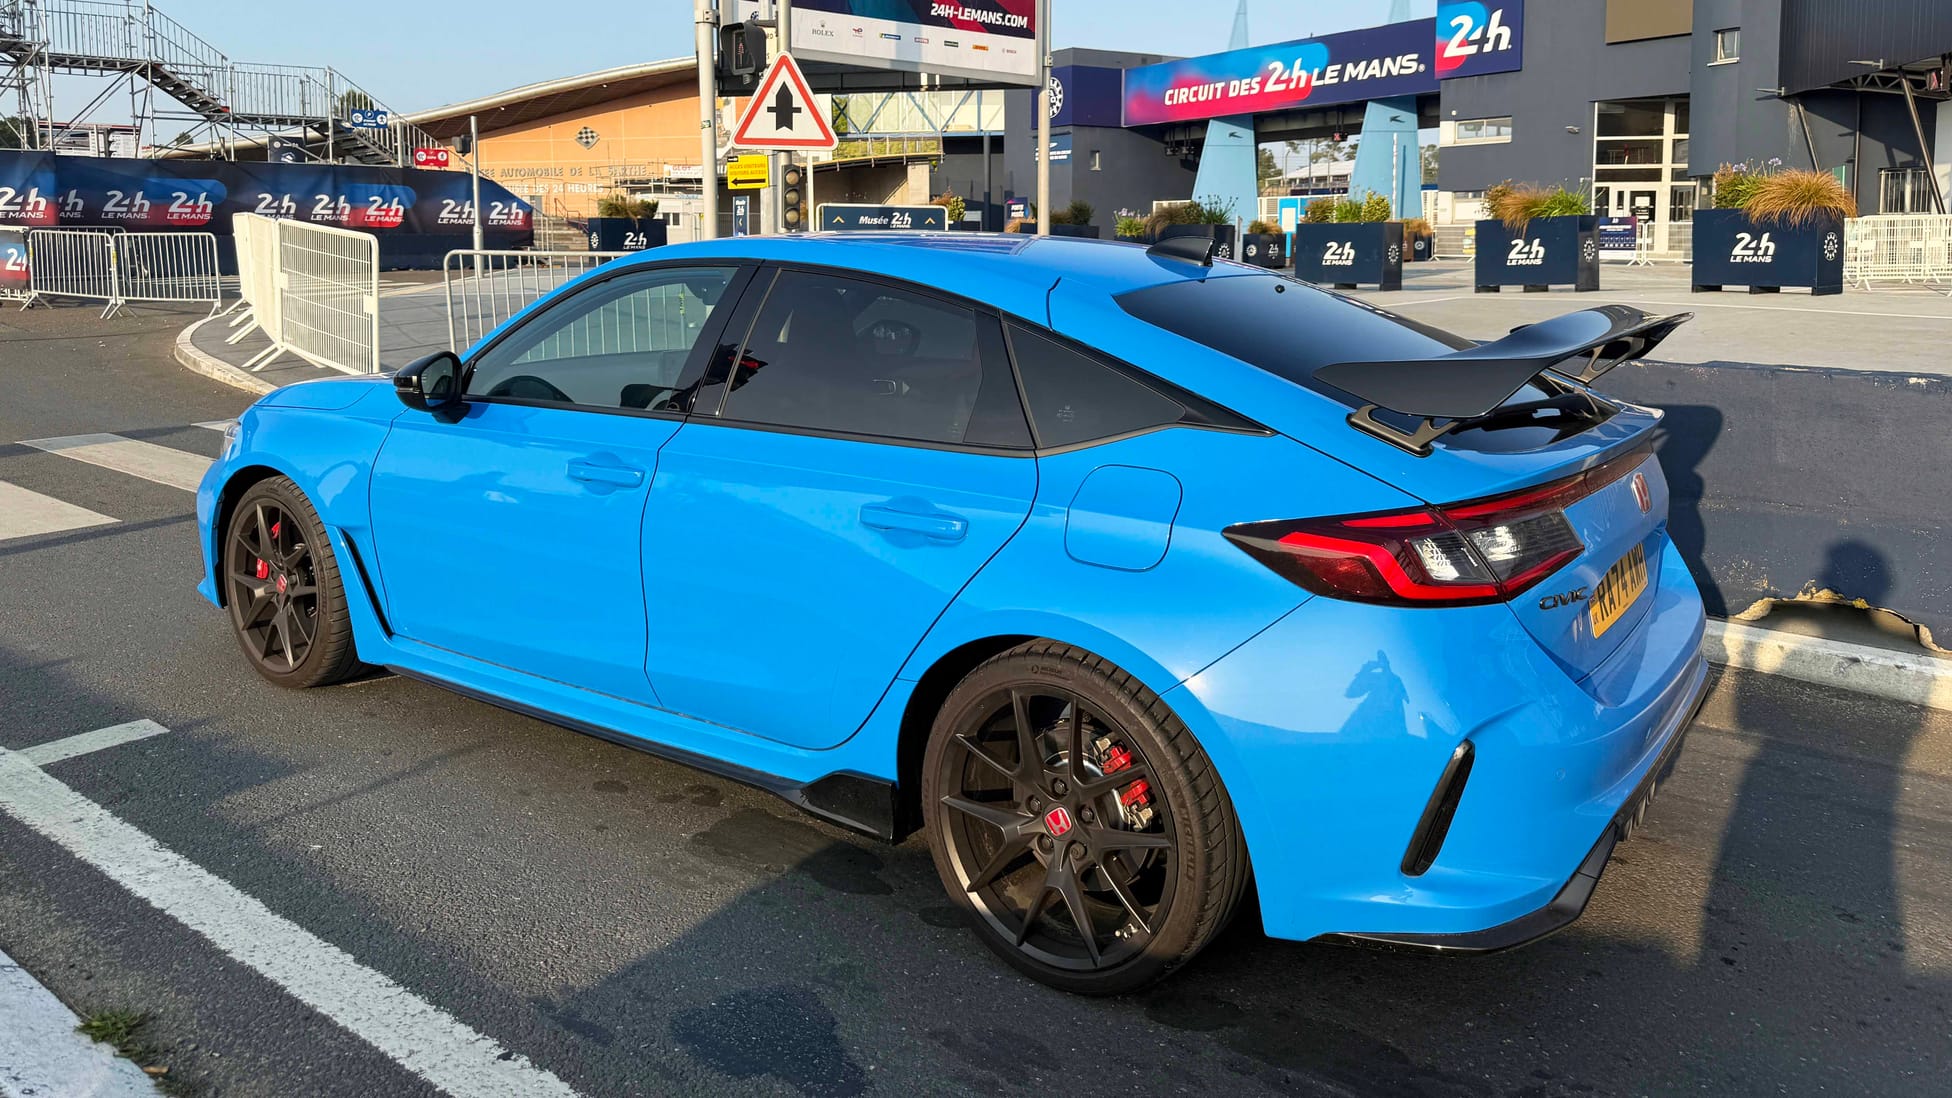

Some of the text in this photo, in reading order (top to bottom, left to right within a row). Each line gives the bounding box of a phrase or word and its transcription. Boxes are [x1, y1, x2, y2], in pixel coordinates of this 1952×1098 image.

[930, 3, 1028, 29] 24H-LEMANS.COM
[812, 29, 834, 37] ROLEX
[1443, 9, 1511, 57] 24h
[1164, 83, 1225, 105] CIRCUIT
[1228, 76, 1261, 97] DES
[1264, 58, 1307, 92] 24h
[1311, 68, 1339, 87] LE
[501, 167, 564, 177] AUTOMOBILE
[569, 167, 582, 176] DE
[533, 184, 549, 193] DES
[553, 184, 563, 193] 24
[568, 183, 604, 193] HEURES
[0, 187, 47, 211] 24h
[102, 190, 150, 212] 24h
[168, 191, 213, 213] 24h
[254, 193, 297, 214] 24h
[311, 194, 351, 214] 24h
[366, 196, 405, 216] 24h
[439, 199, 475, 218] 24h
[489, 201, 524, 219] 24h
[858, 212, 912, 225] Musée 24h
[624, 232, 647, 245] 24h
[1508, 238, 1545, 259] 24h
[1731, 232, 1776, 256] 24h
[1323, 241, 1355, 259] 24h
[1539, 586, 1588, 610] CIVIC
[1597, 557, 1628, 621] RA74
